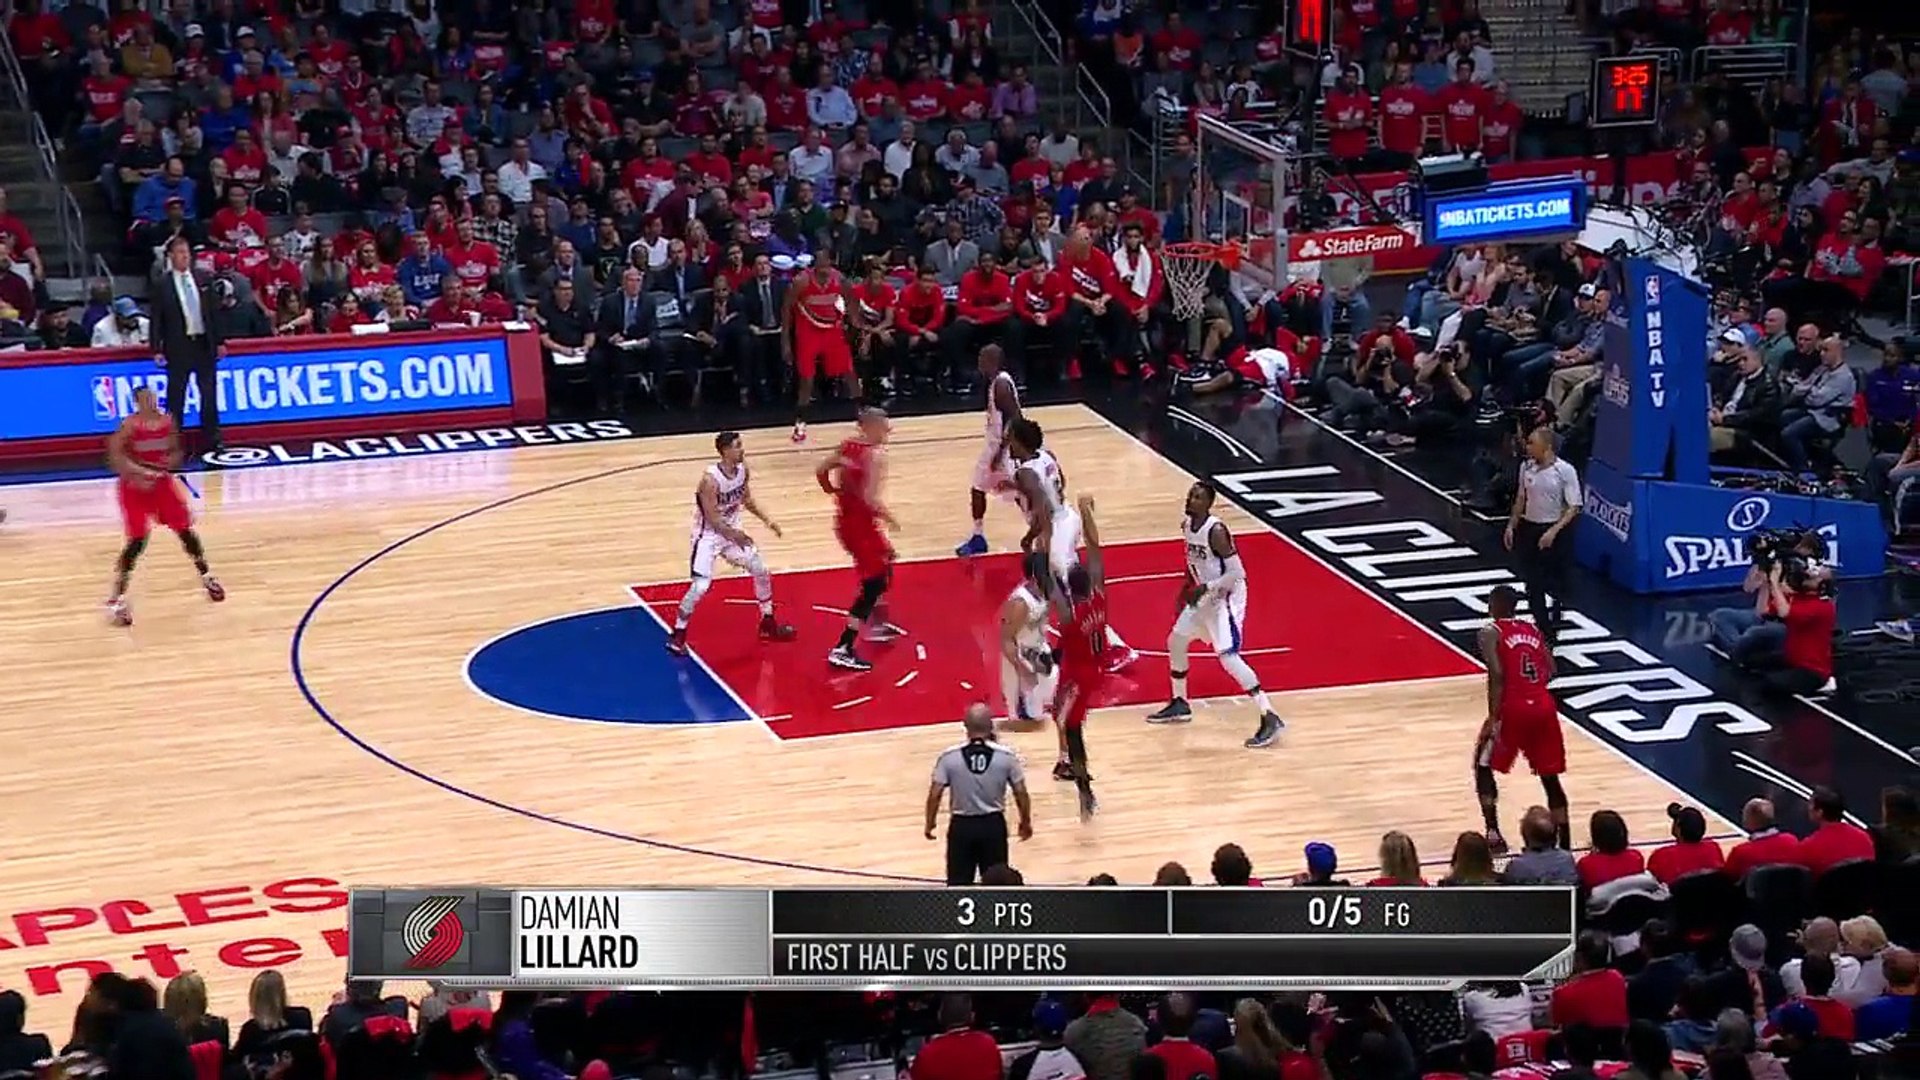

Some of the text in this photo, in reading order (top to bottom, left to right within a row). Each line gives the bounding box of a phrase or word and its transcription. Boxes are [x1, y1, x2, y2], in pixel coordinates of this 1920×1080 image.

[1646, 310, 1665, 408] NBA TV
[202, 418, 633, 467] @LACLIPPERS
[1213, 465, 1384, 518] LA
[1665, 523, 1840, 578] SPALG
[1520, 652, 1538, 683] 4
[970, 753, 987, 771] 10
[0, 877, 350, 950] PLES
